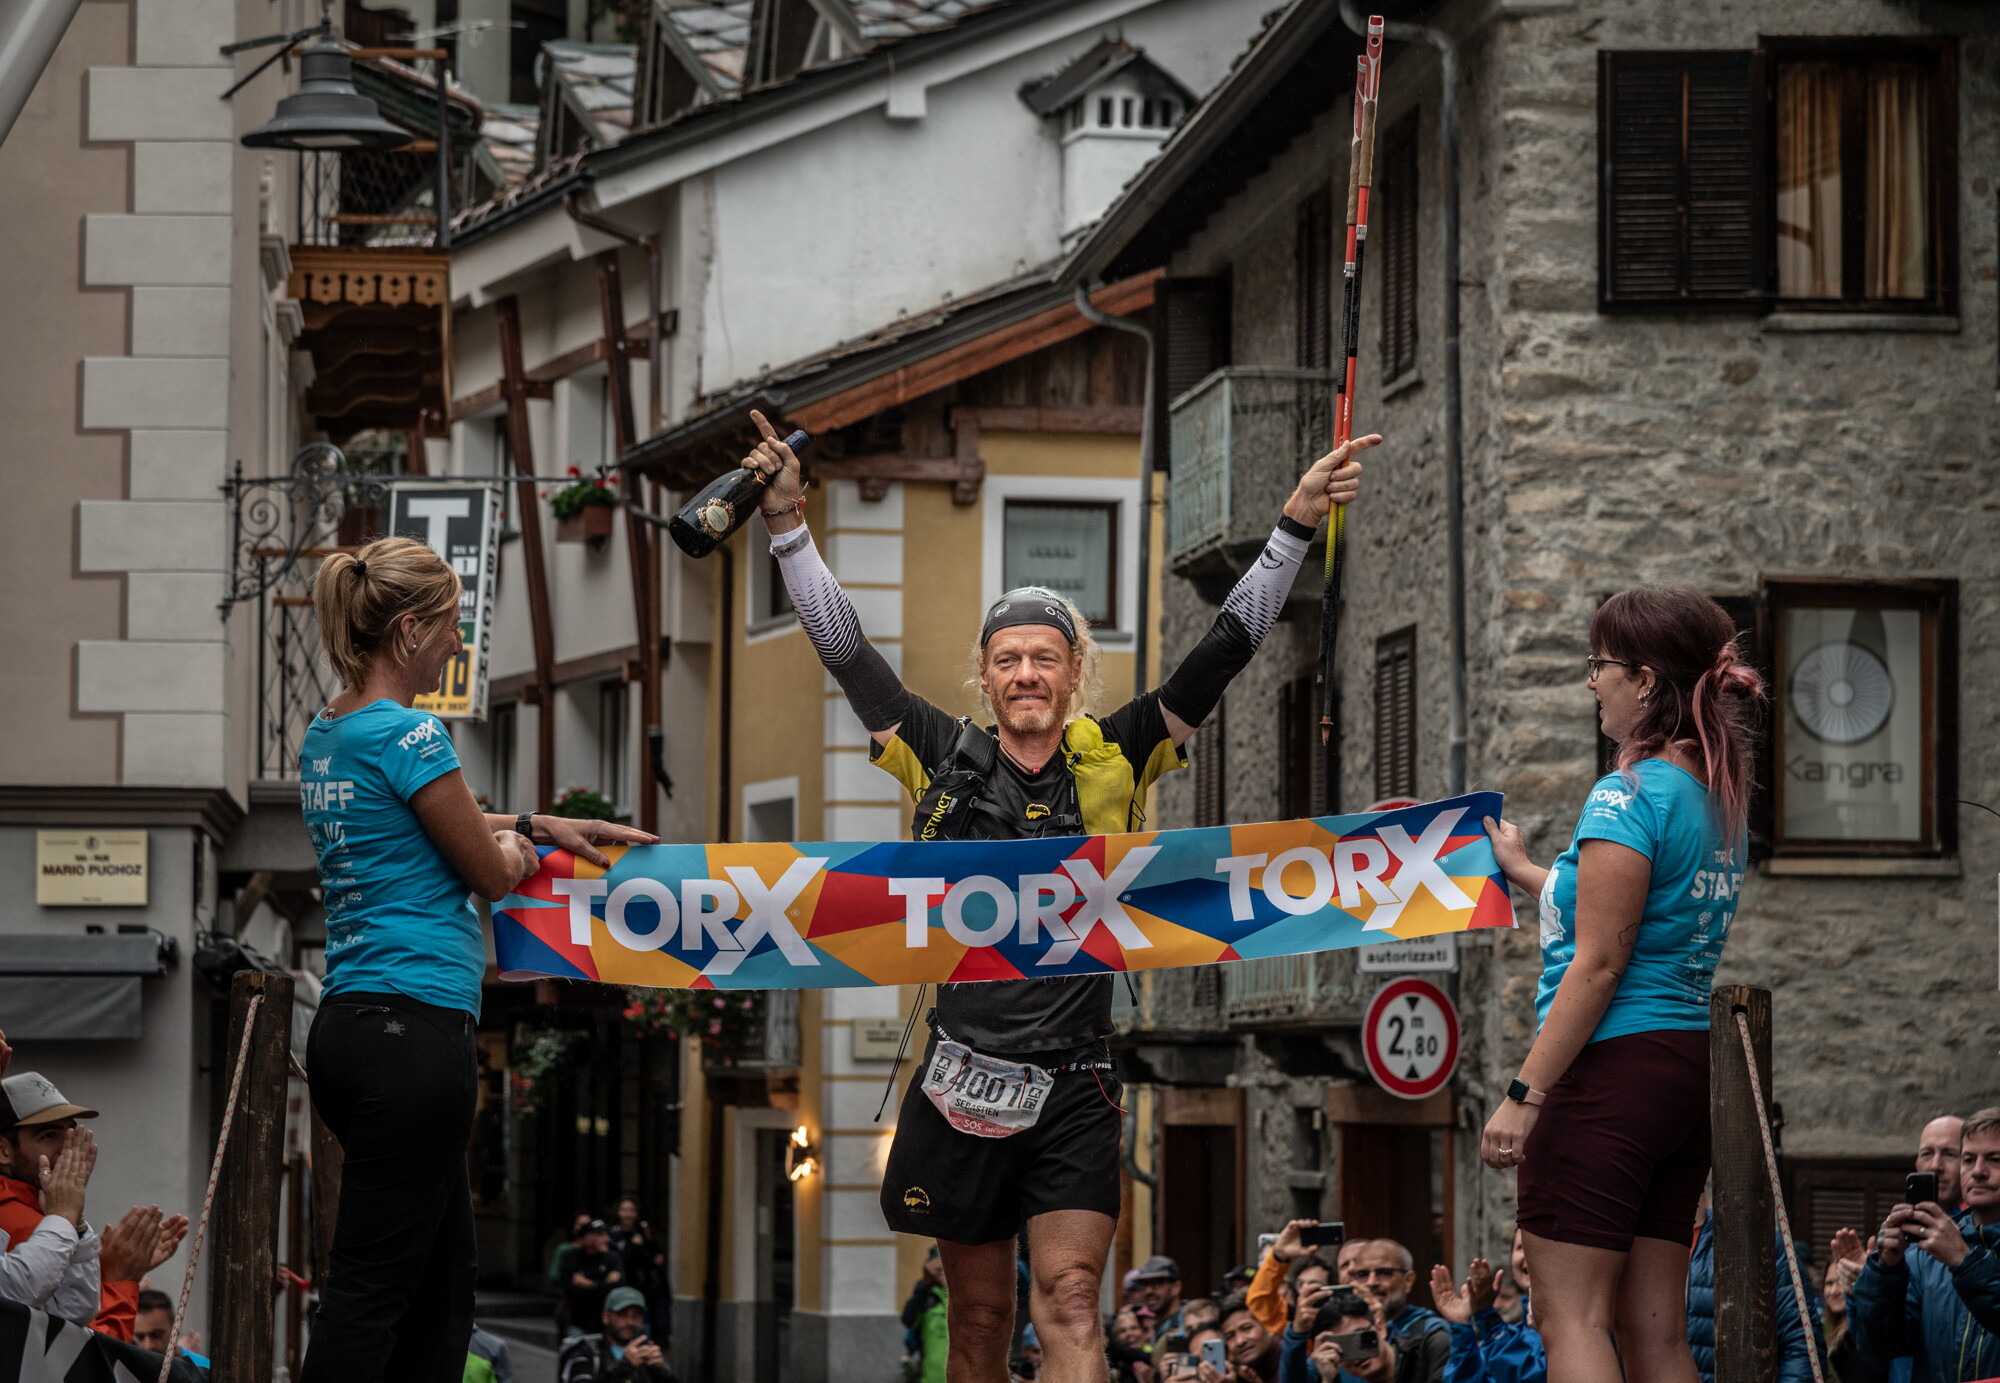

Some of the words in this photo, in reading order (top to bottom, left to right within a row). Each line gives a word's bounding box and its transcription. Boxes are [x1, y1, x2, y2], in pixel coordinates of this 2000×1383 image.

[407, 497, 470, 563] T
[397, 718, 441, 751] TORX
[312, 756, 332, 777] TORX
[1591, 789, 1633, 811] TORX
[43, 865, 86, 876] MARIO
[1215, 806, 1478, 931] TORX
[1690, 869, 1745, 901] STAF
[552, 857, 830, 975] TORX
[888, 845, 1163, 966] TORX
[1366, 948, 1448, 964] autorizzati
[948, 1066, 1023, 1108] 4001
[955, 1098, 999, 1118] SEBASTIEN
[963, 1119, 982, 1131] SOS
